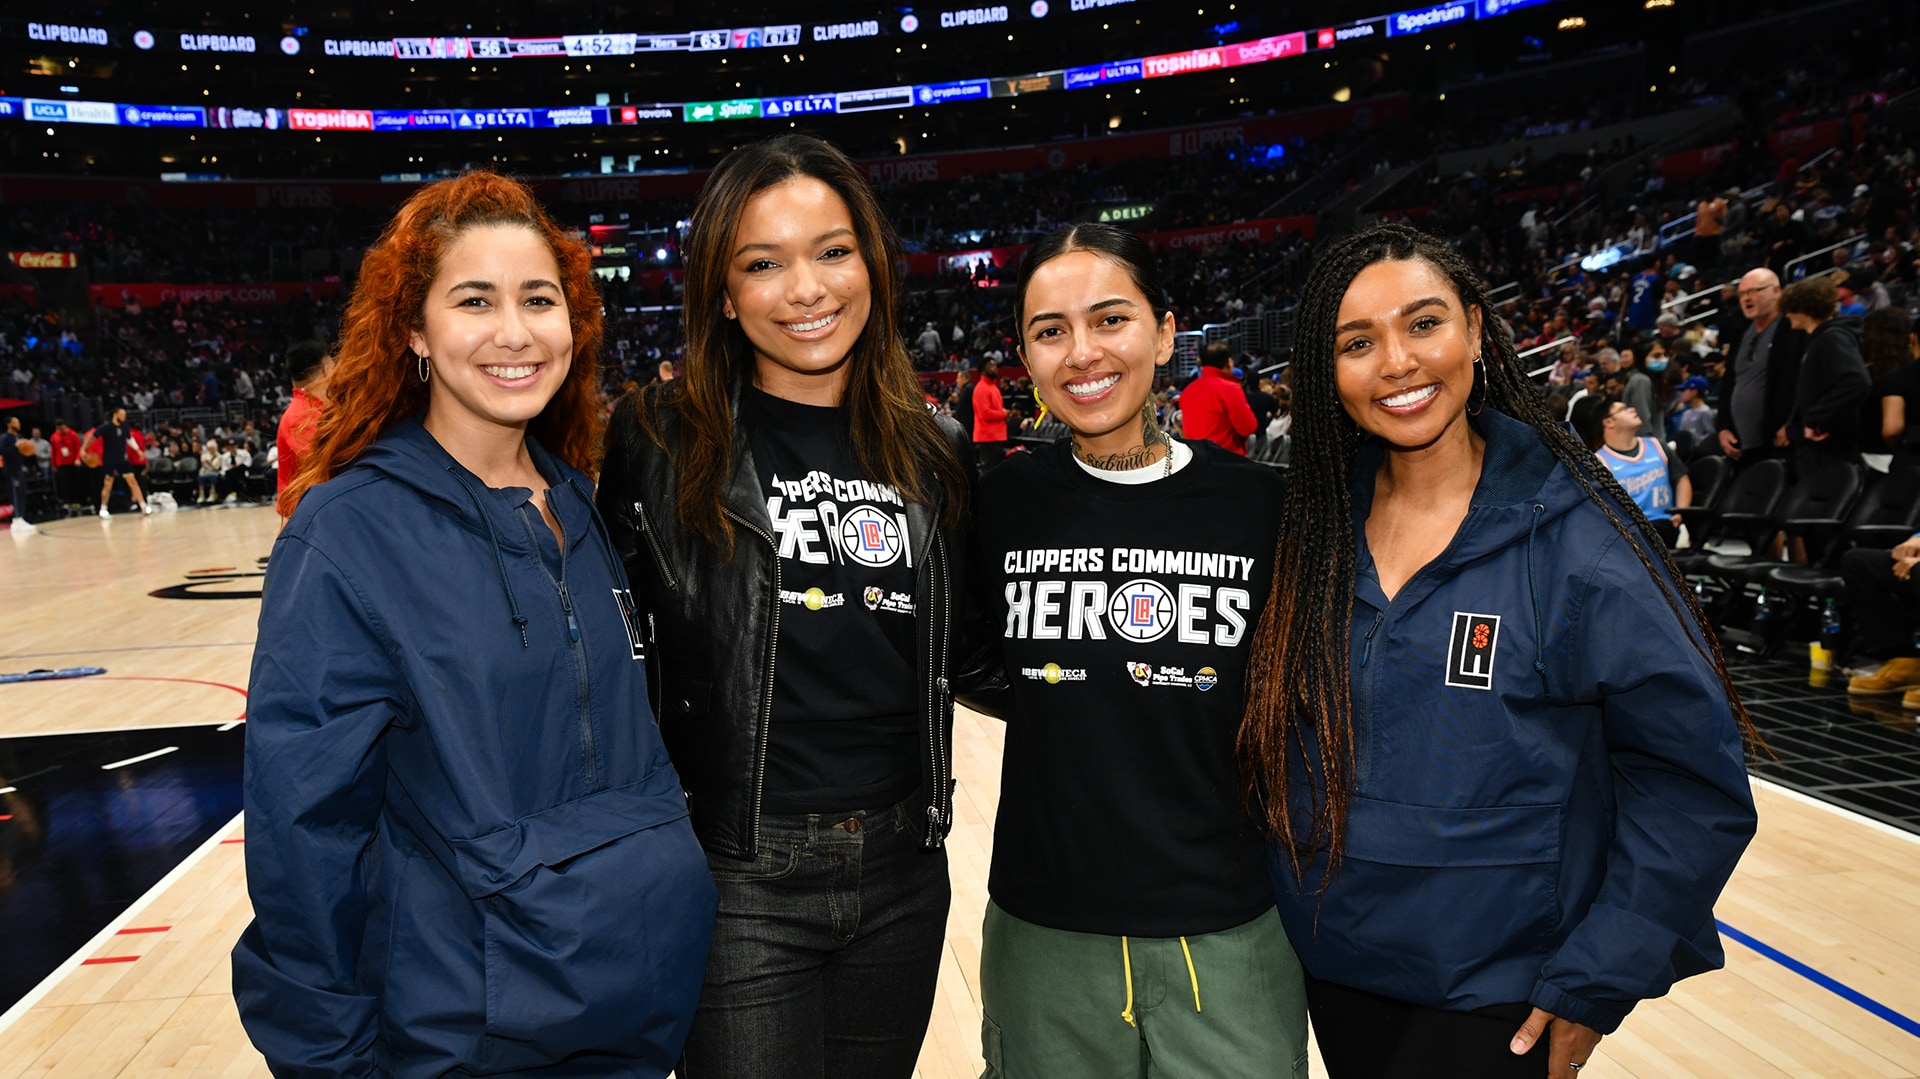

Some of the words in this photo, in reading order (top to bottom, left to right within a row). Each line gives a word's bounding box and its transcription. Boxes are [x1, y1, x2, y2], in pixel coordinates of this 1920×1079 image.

[941, 6, 1008, 28] CLIPBOARD
[1397, 5, 1465, 31] Spectrum
[28, 22, 108, 46] CLIPBOARD
[813, 20, 879, 42] CLIPBOARD
[1336, 25, 1374, 41] TOYOTA
[181, 34, 256, 52] CLIPBOARD
[574, 38, 612, 53] 4:52
[651, 38, 677, 48] 76ers
[700, 33, 721, 48] 63
[733, 31, 761, 48] 76
[324, 39, 394, 57] CLIPBOARD
[479, 40, 500, 56] 56
[517, 42, 559, 54] Clippers
[1146, 50, 1221, 74] TOSHIBA
[1107, 65, 1140, 79] ULTRA
[933, 85, 982, 98] crypto.com
[35, 104, 65, 117] UCLA
[71, 104, 112, 120] Health
[719, 102, 754, 118] Sprite
[782, 98, 833, 112] DELTA
[141, 111, 196, 122] crypto.com
[293, 110, 370, 128] TOSHIBA
[415, 115, 449, 125] ULTRA
[474, 113, 527, 125] DELTA
[548, 109, 592, 118] AMERICAN
[638, 109, 672, 118] TOYOTA
[883, 160, 939, 184] CLIPPERS
[1633, 286, 1645, 304] 2
[834, 478, 904, 507] COMM
[1652, 485, 1670, 508] 13
[1004, 548, 1105, 574] CLIPPERS
[1111, 548, 1255, 581] COMMUNITY
[882, 599, 897, 608] Pipe
[890, 592, 911, 603] SoCal
[1004, 579, 1251, 647] HEROES
[1021, 667, 1048, 677] IBEW
[1057, 669, 1088, 678] NECA
[1152, 673, 1169, 683] Pipe
[1169, 675, 1193, 684] Trades
[1160, 666, 1185, 676] SoCal
[1194, 675, 1218, 683] CPMCA
